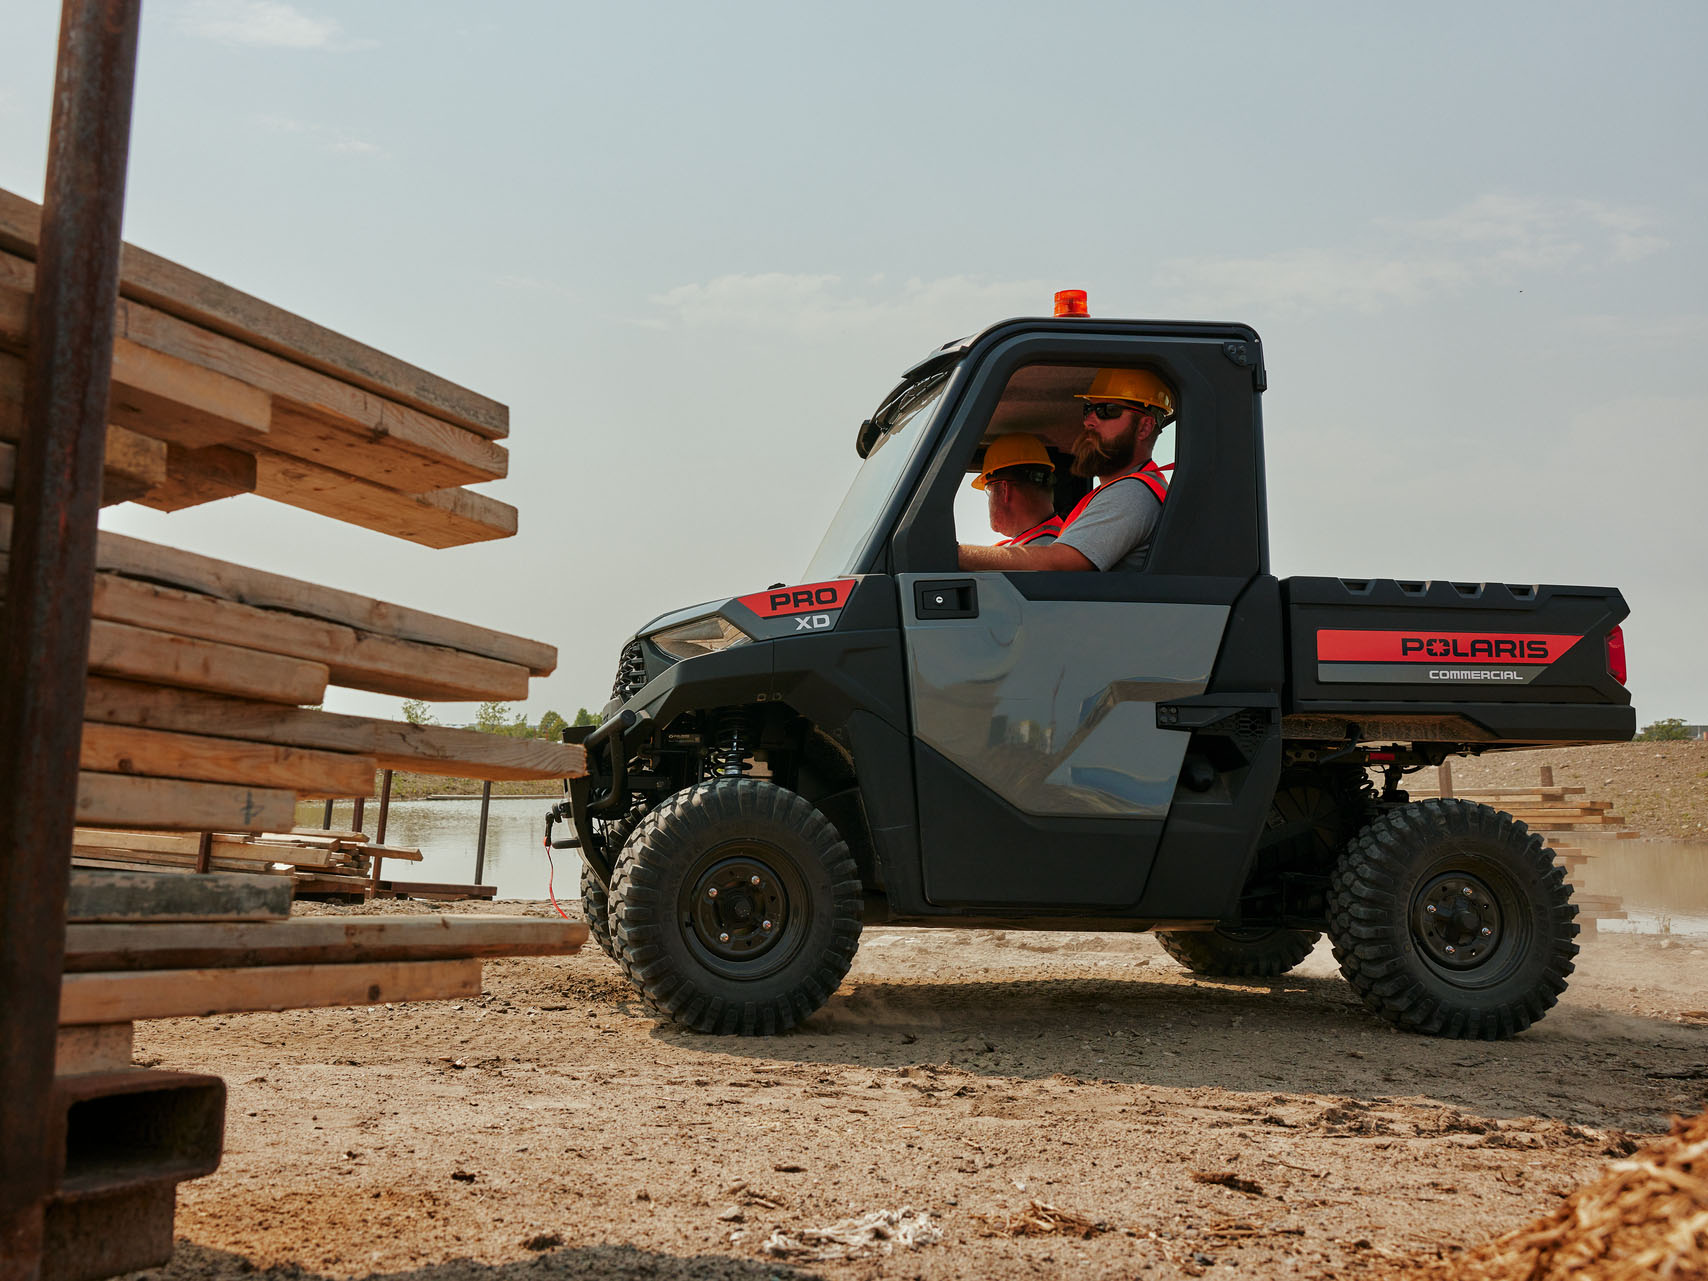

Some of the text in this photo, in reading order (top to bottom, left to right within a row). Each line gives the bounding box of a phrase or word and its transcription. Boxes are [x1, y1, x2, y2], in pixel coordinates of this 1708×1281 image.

[769, 587, 838, 611] PRO
[794, 614, 831, 631] XD
[1401, 637, 1549, 659] POLARIS
[1429, 669, 1524, 680] COMMERCIAL
